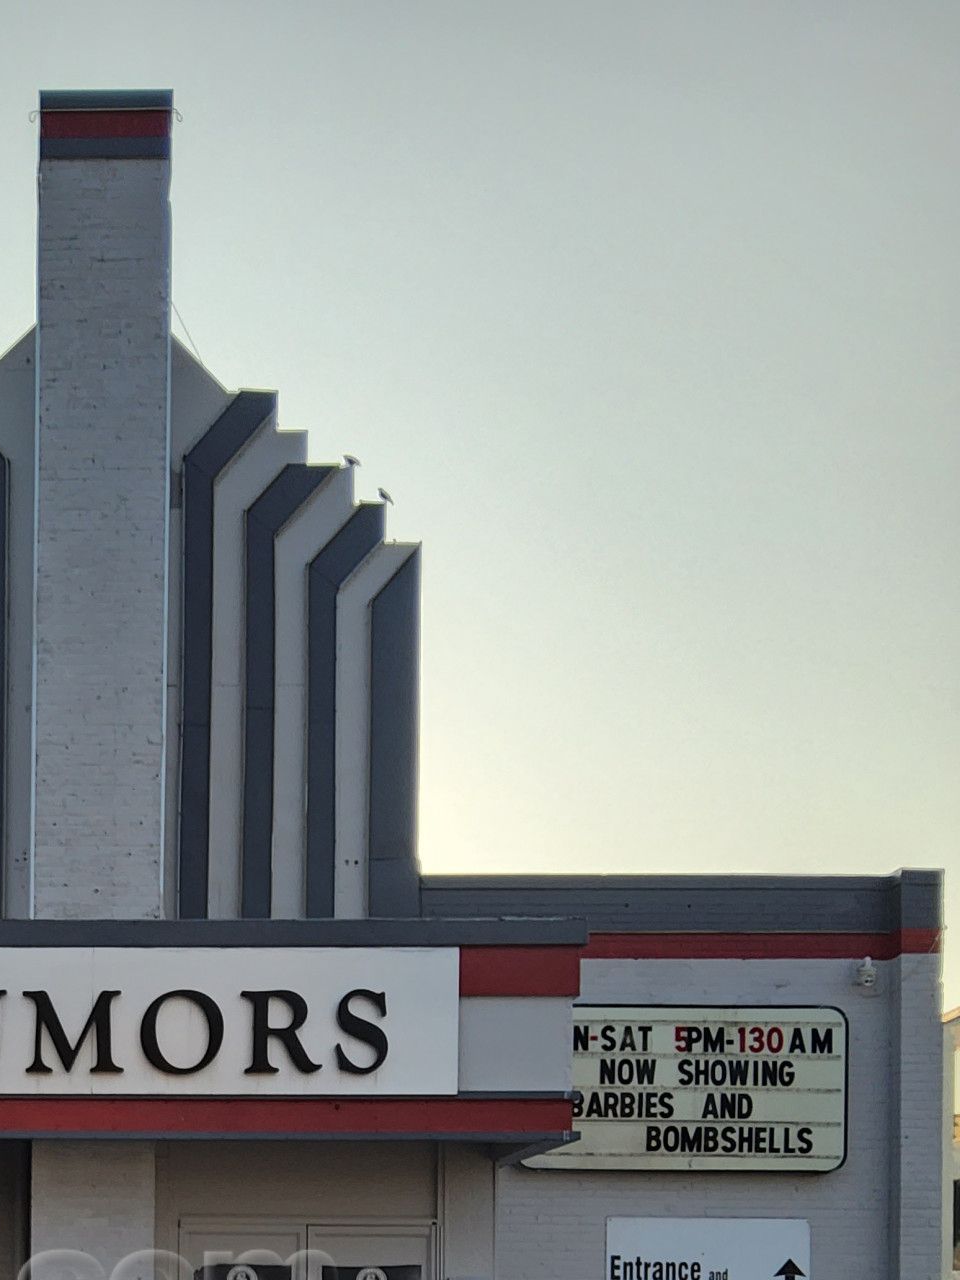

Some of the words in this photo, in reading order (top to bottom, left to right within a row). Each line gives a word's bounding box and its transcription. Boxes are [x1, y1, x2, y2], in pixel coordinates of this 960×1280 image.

[600, 1059, 656, 1085] NOW
[678, 1059, 795, 1086] SHOWING
[702, 1093, 753, 1119] AND
[646, 1126, 813, 1153] BOMBSHELLS
